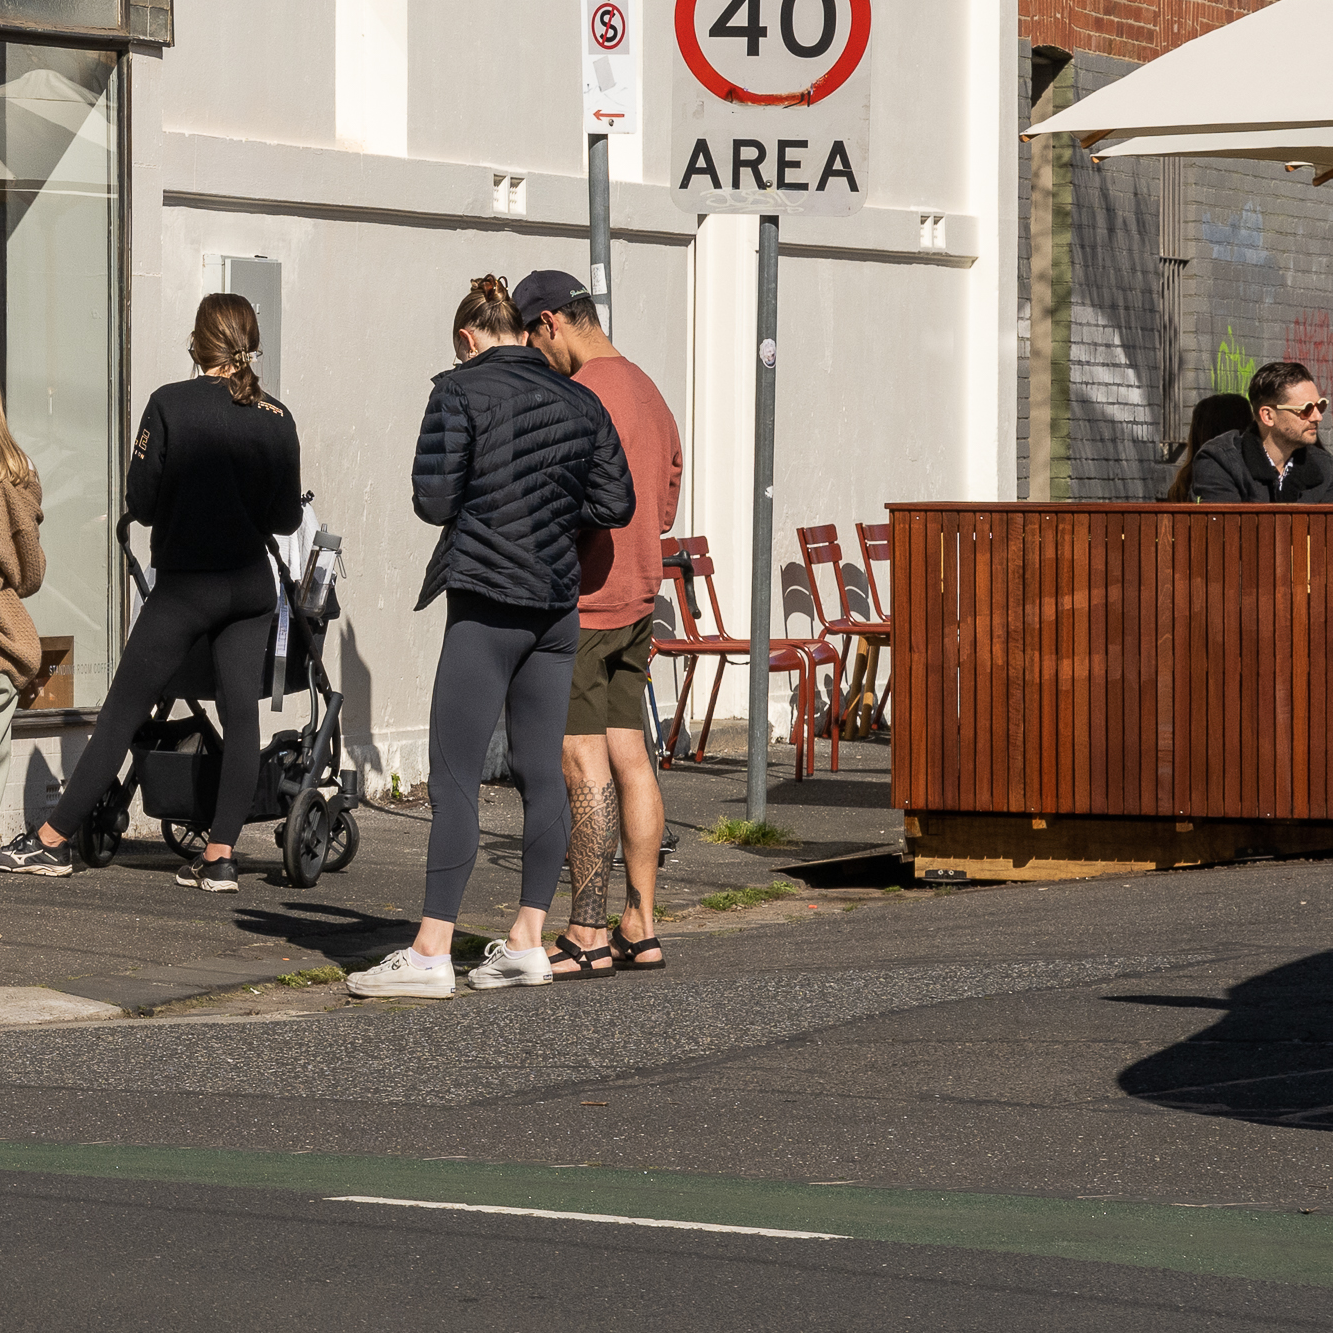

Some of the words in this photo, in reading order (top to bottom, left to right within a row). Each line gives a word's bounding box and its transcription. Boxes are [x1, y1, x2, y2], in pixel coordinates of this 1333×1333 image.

[678, 138, 860, 193] AREA
[48, 664, 74, 676] STANDING
[77, 663, 93, 675] ROOM
